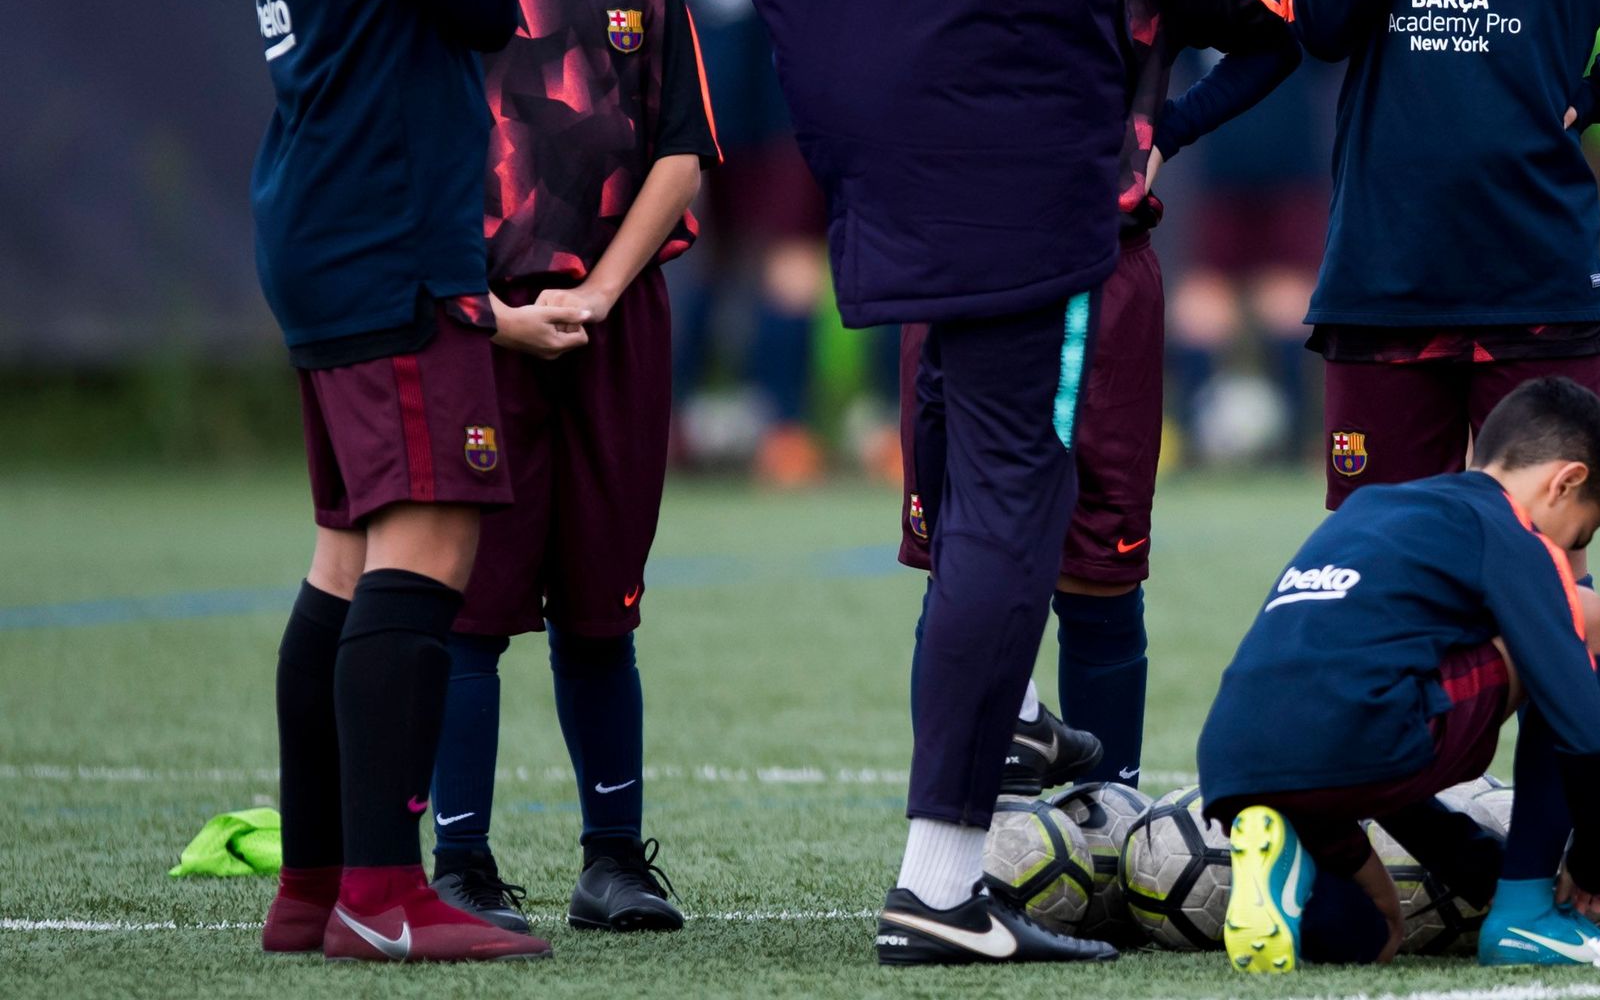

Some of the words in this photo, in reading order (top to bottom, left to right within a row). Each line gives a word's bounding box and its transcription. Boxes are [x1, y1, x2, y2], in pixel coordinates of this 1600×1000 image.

[1388, 10, 1479, 37] Academy
[1486, 13, 1521, 34] Pro
[1410, 35, 1448, 51] New
[1451, 35, 1489, 52] York
[1277, 564, 1361, 592] beko
